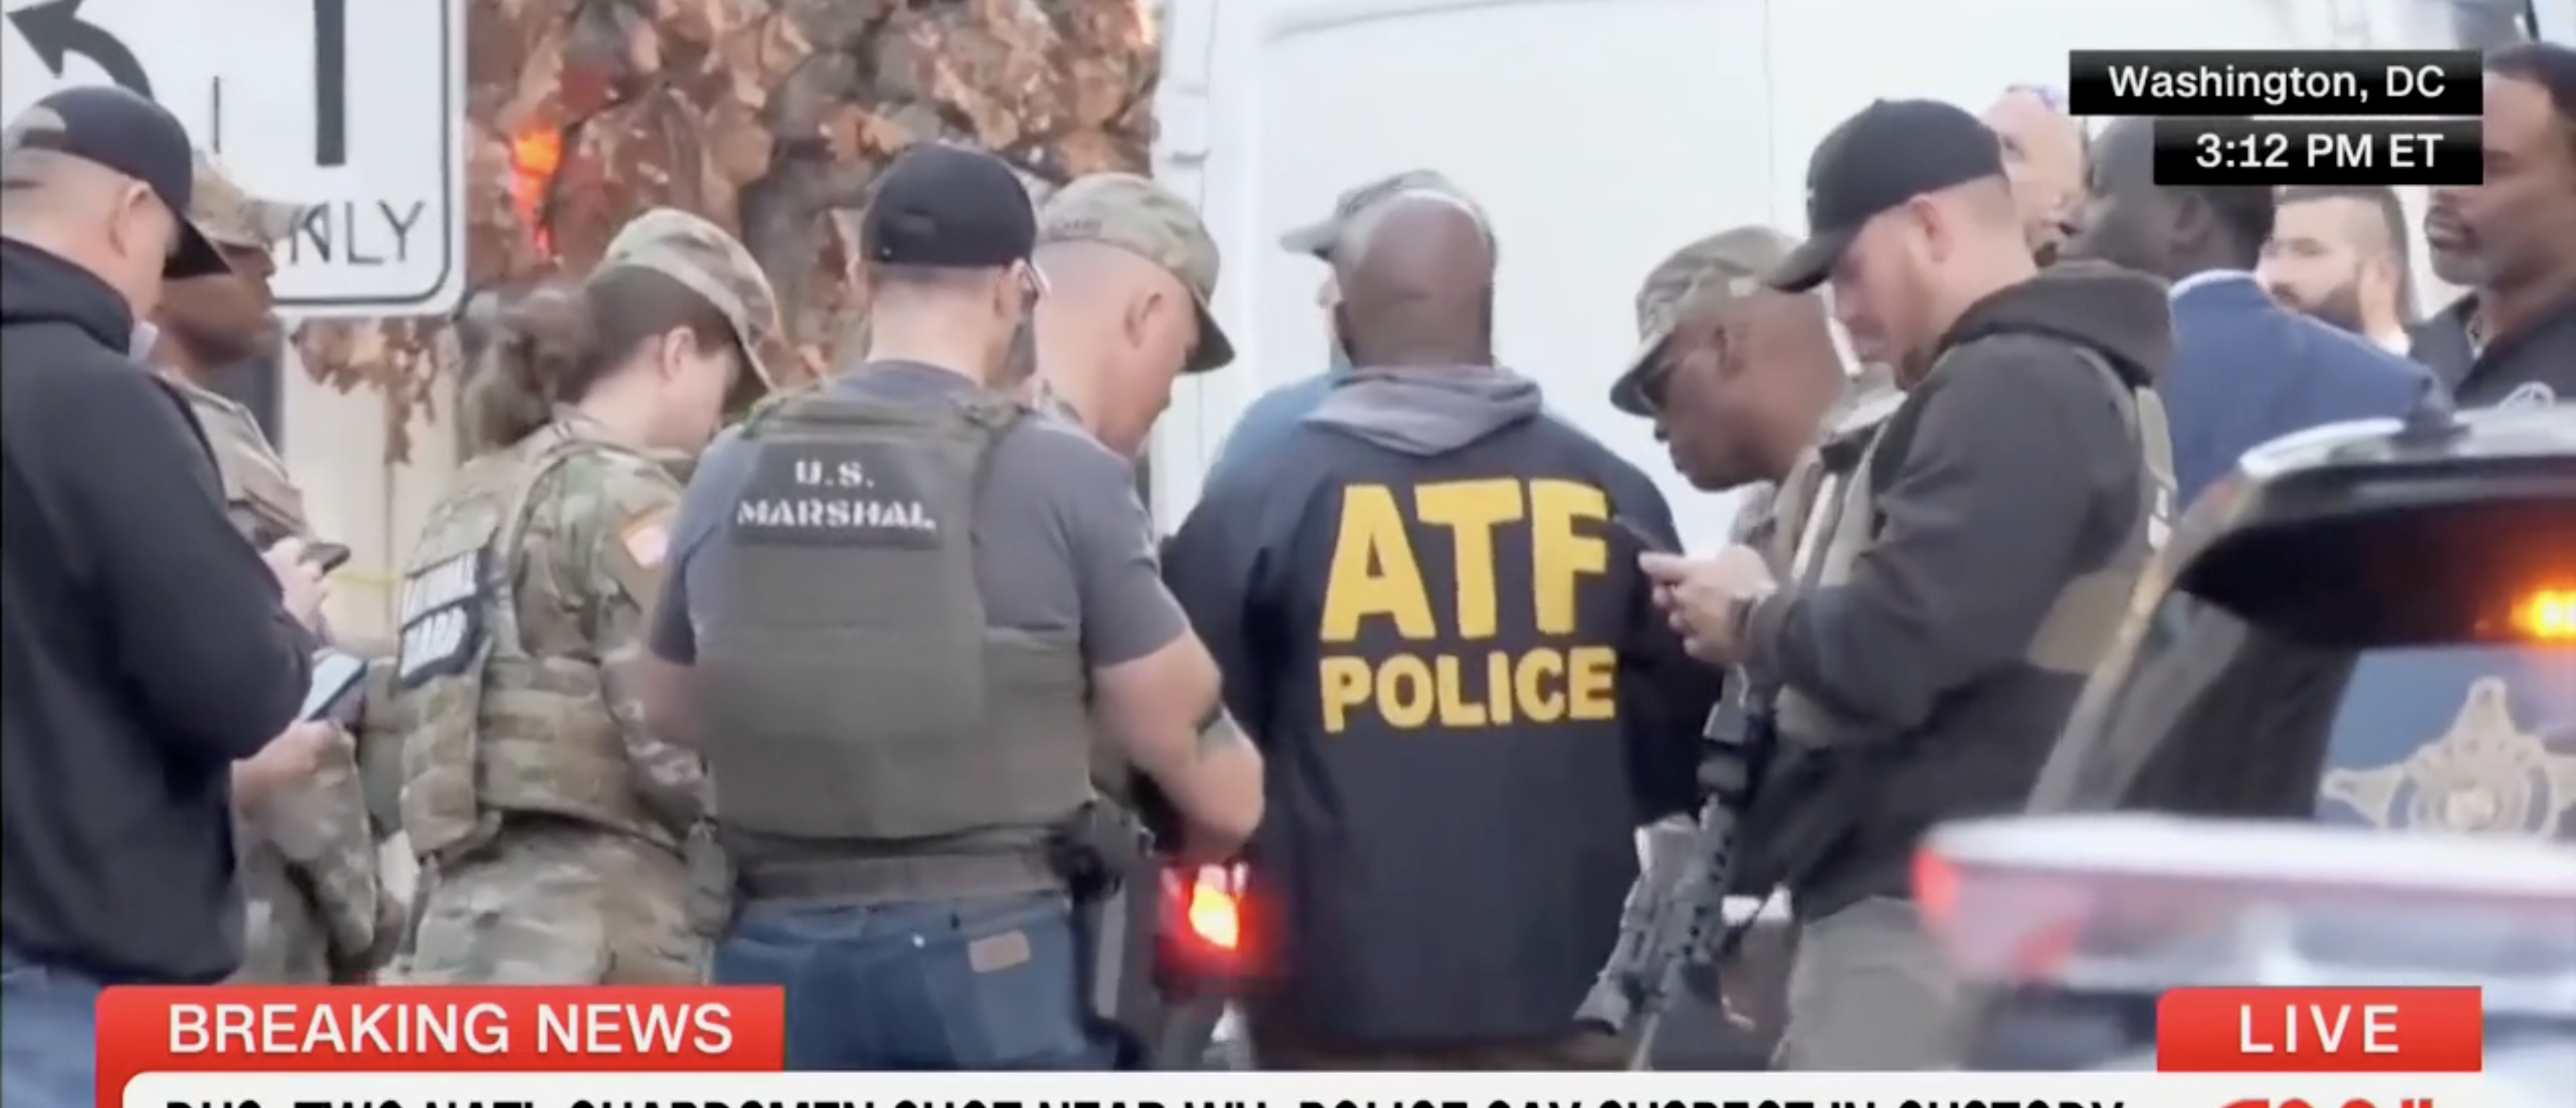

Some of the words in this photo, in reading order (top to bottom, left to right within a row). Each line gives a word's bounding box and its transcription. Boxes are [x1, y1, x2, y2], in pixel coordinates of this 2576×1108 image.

[289, 201, 424, 264] NLY
[795, 459, 875, 488] U.S.
[737, 499, 936, 529] MARSHAL
[1321, 479, 1610, 642] ATF
[1320, 648, 1616, 733] POLICE
